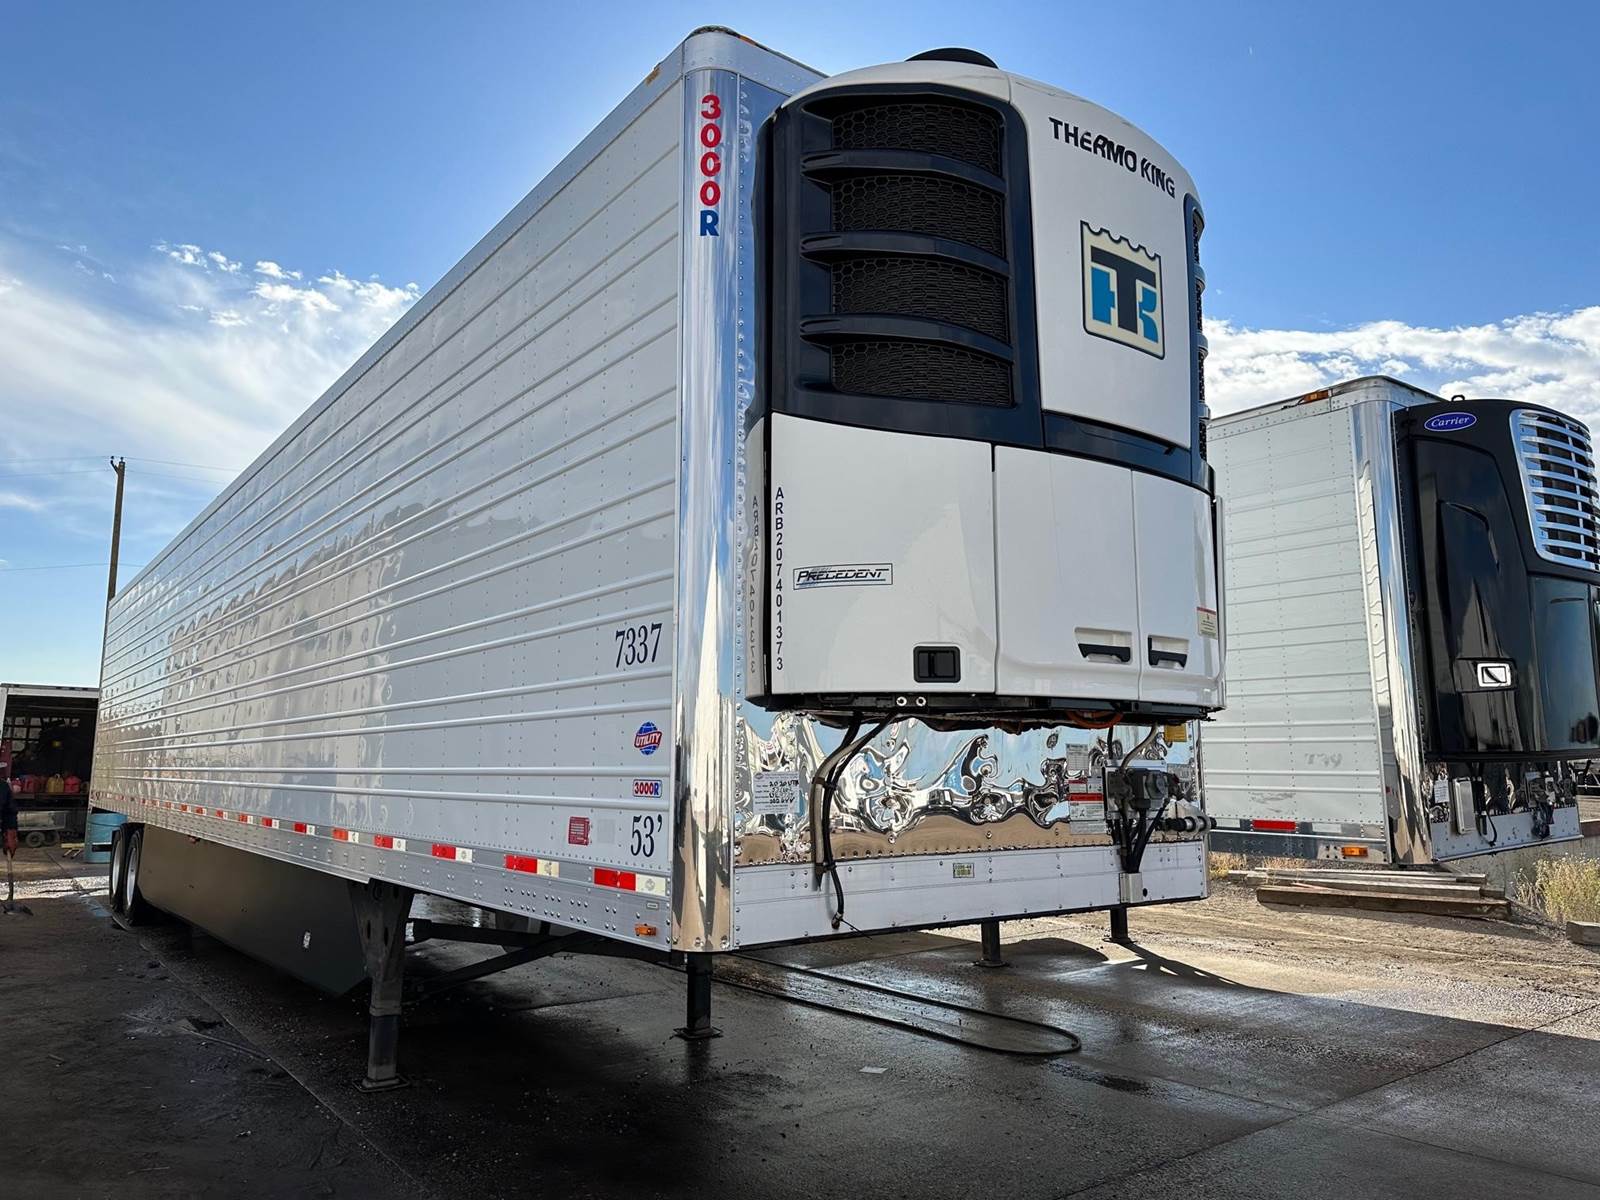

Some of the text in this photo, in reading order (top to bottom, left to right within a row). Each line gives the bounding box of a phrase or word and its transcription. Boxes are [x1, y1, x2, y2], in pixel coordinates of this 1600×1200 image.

[700, 94, 721, 236] 3000R
[1049, 117, 1176, 199] THERMO KING
[1431, 417, 1470, 427] Carrier
[775, 487, 784, 670] ARB207401373
[797, 568, 890, 582] PRECEDENT
[615, 623, 662, 668] 7337
[635, 733, 661, 747] UTILITY
[634, 782, 660, 795] 3000R
[630, 815, 663, 857] 53'
